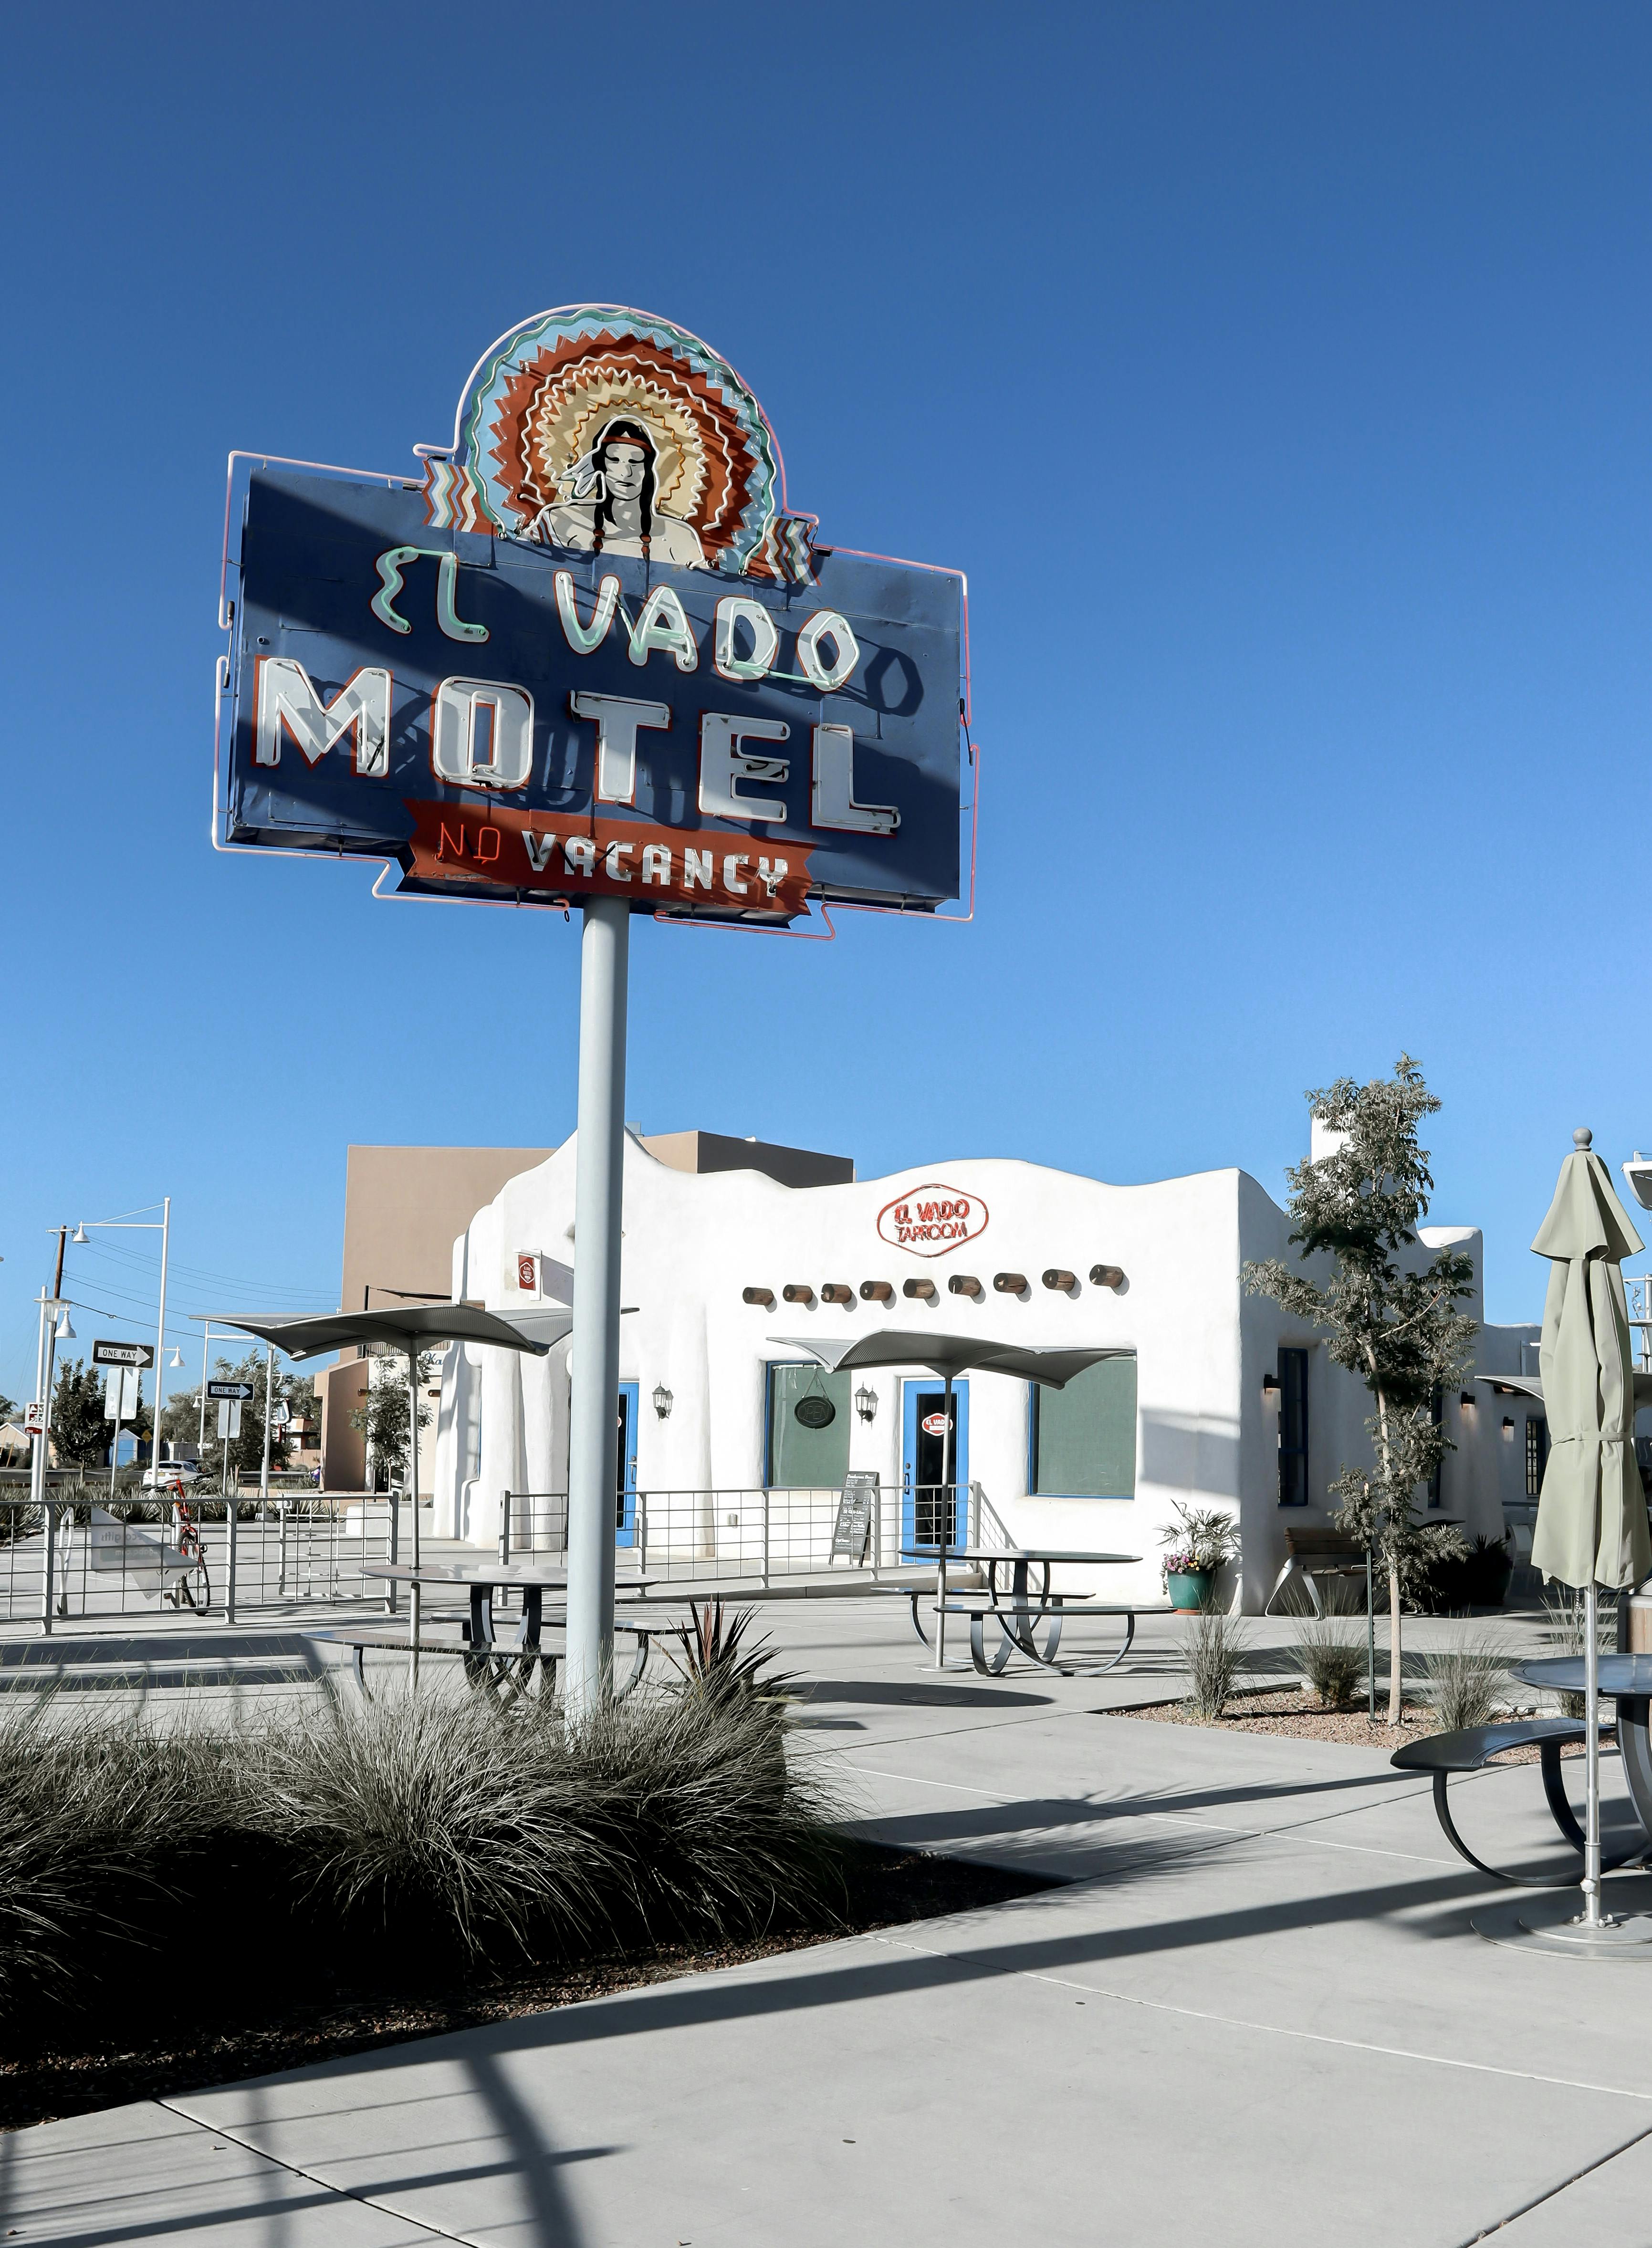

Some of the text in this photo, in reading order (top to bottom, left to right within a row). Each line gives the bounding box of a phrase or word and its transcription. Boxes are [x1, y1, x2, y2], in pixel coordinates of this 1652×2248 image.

[369, 544, 861, 692] EL VADO
[251, 654, 901, 837] MOTEL
[435, 822, 789, 897] NO VACANCY
[894, 1199, 970, 1224] EL VADO
[894, 1221, 968, 1243] TAPROOM
[103, 1349, 137, 1359] ONE WAY
[797, 1405, 830, 1420] OPEN
